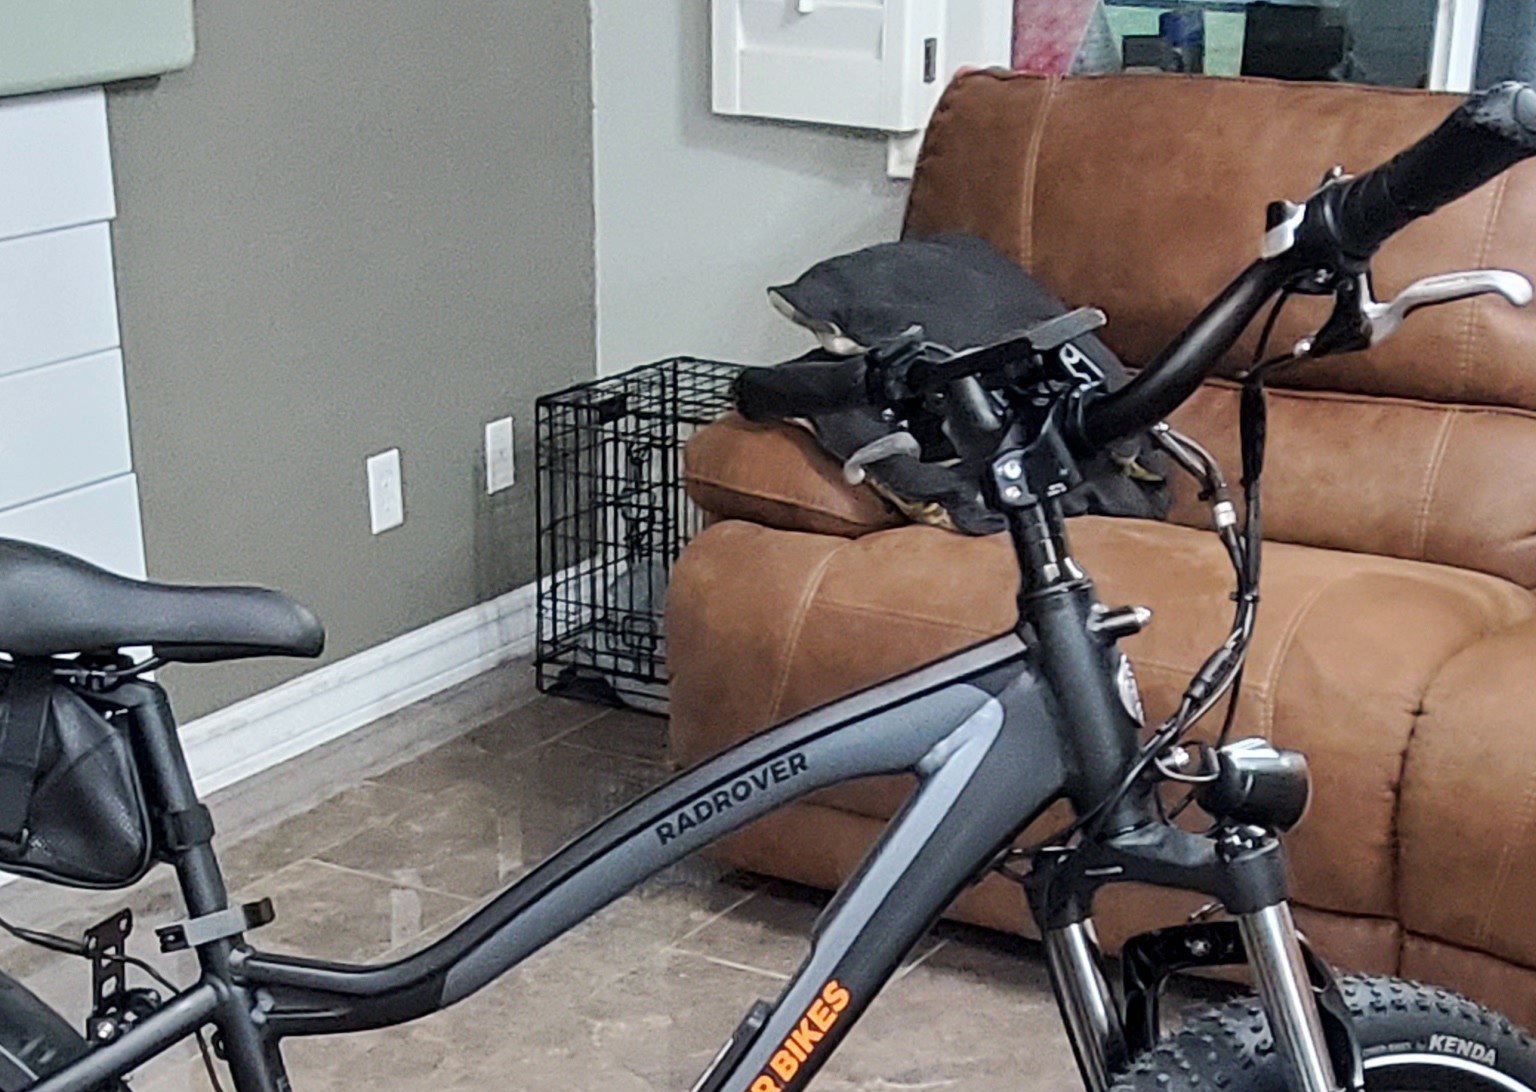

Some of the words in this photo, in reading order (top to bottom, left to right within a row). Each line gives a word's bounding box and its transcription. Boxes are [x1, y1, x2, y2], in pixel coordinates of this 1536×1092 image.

[656, 752, 809, 846] RADROVER
[769, 979, 851, 1082] BIKES
[1429, 1033, 1497, 1066] KENDA
